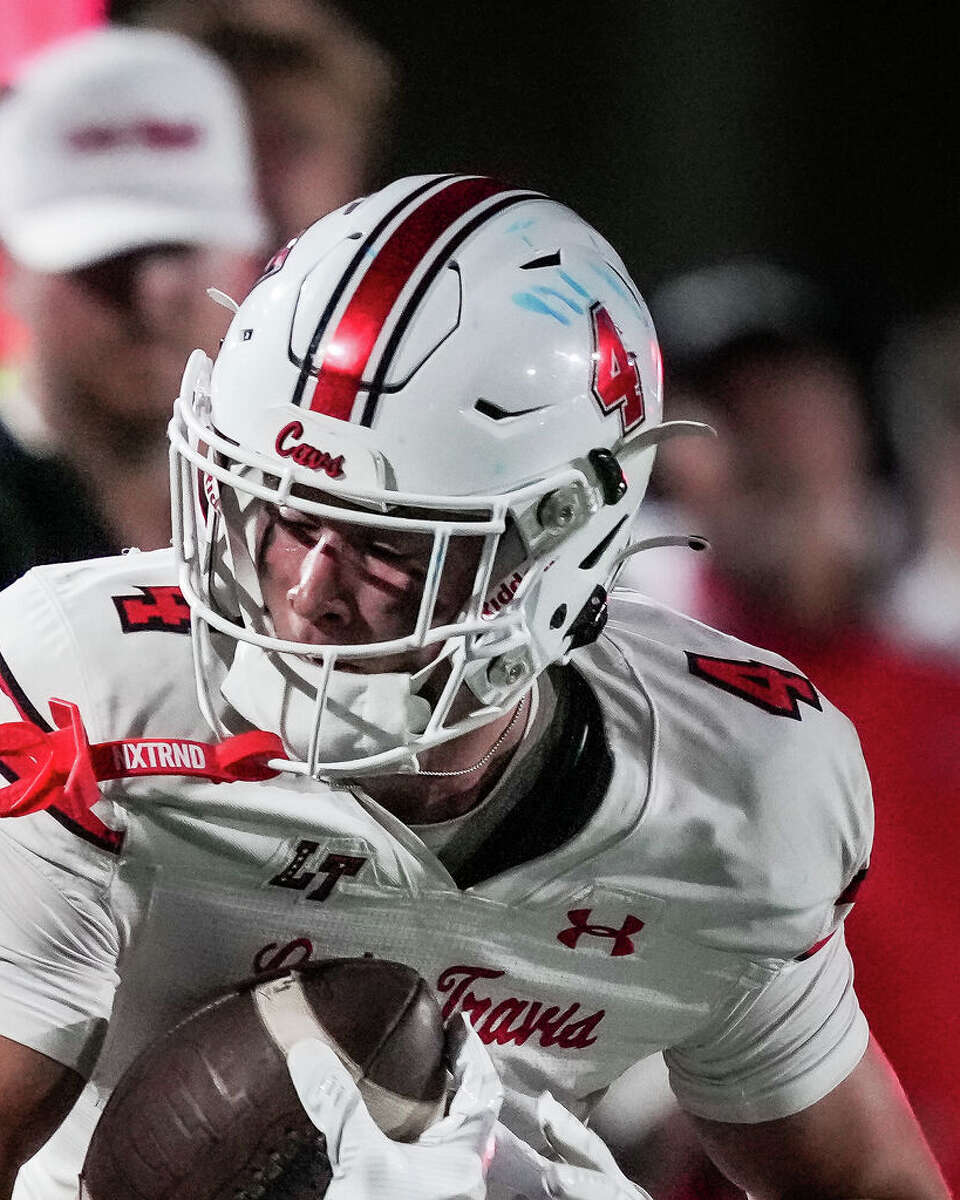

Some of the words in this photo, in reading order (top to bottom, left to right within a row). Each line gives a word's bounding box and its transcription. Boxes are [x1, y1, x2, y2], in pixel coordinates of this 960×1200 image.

[589, 300, 646, 438] 4
[275, 420, 346, 478] Cavs
[682, 650, 824, 721] 4
[111, 742, 206, 770] NXTRND
[268, 839, 368, 902] LT
[437, 965, 606, 1050] Travis
